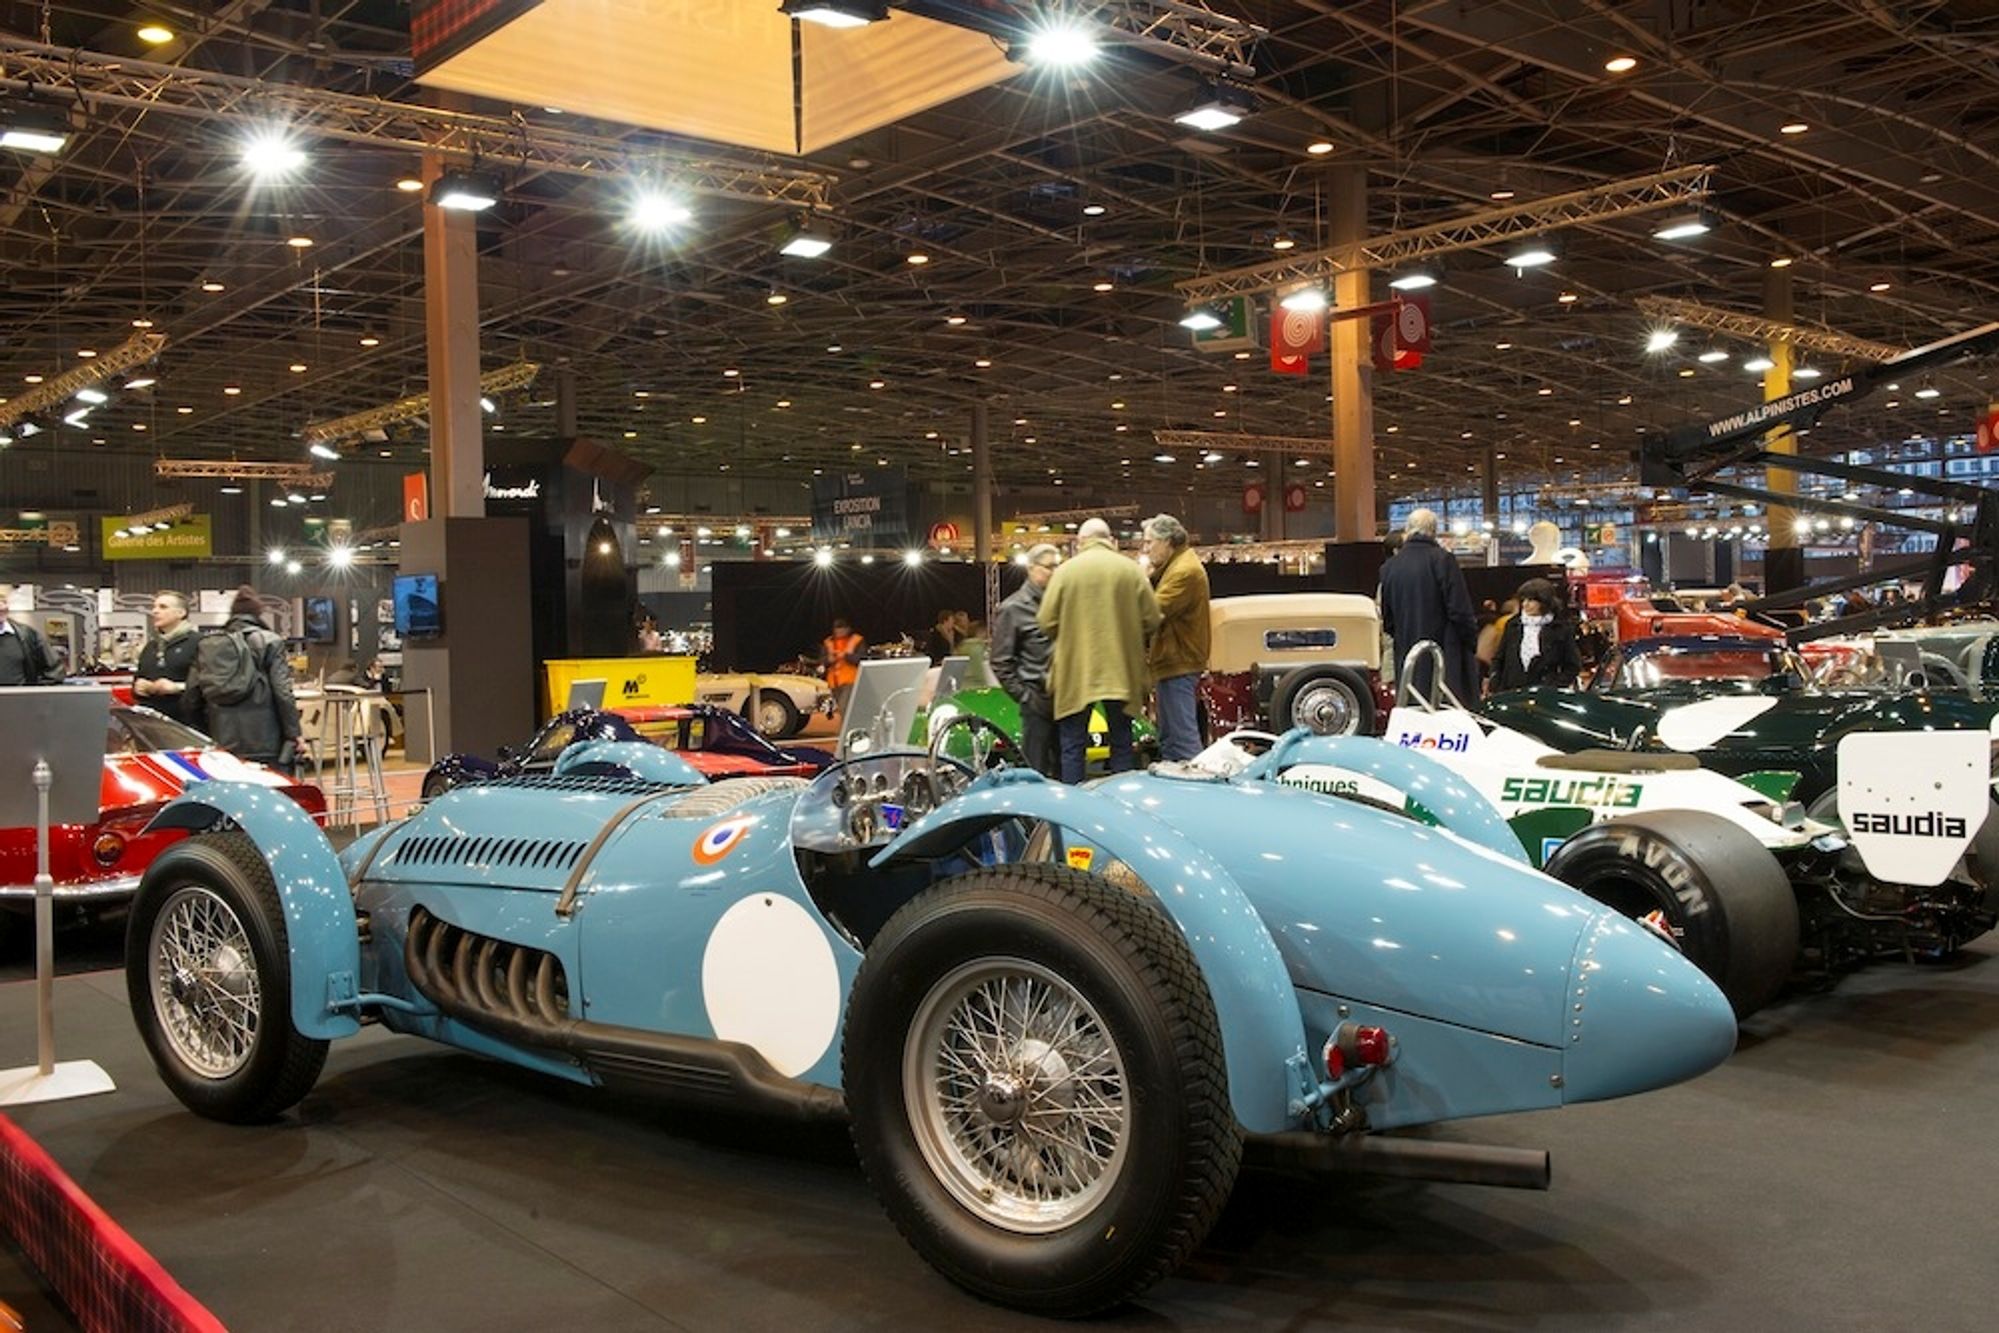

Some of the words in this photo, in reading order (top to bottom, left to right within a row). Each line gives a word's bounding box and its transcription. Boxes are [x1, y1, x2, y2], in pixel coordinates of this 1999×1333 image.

[1709, 378, 1853, 437] WWW.ALPINISTES.COM
[833, 496, 880, 514] EXPOSITION
[146, 535, 164, 547] des
[166, 534, 205, 546] Artistes
[1399, 733, 1469, 752] Mobil
[1275, 774, 1358, 795] hniques
[1501, 776, 1643, 808] saudia
[1853, 811, 1966, 839] saudia
[1618, 835, 1709, 917] AVON
